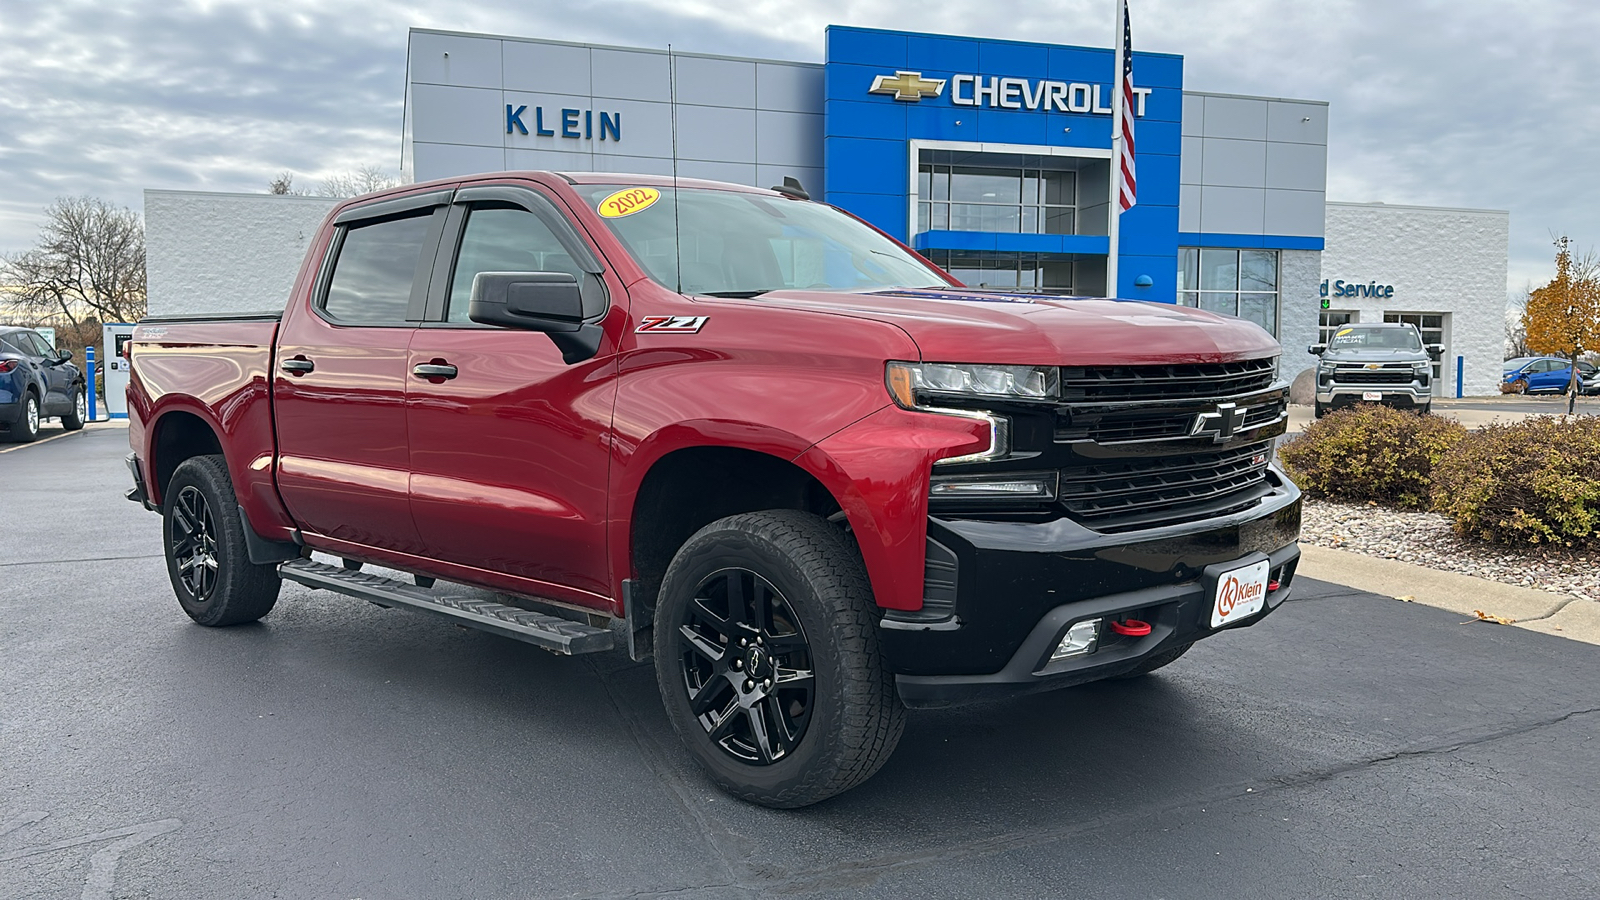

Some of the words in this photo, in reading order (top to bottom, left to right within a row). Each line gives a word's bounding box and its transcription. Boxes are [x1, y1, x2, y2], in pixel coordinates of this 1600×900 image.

[952, 74, 1152, 117] CHEVROLT
[506, 104, 621, 142] KLEIN
[609, 189, 653, 214] 2022
[1335, 280, 1394, 298] Service
[634, 315, 710, 335] Z71
[1237, 580, 1262, 601] Klein
